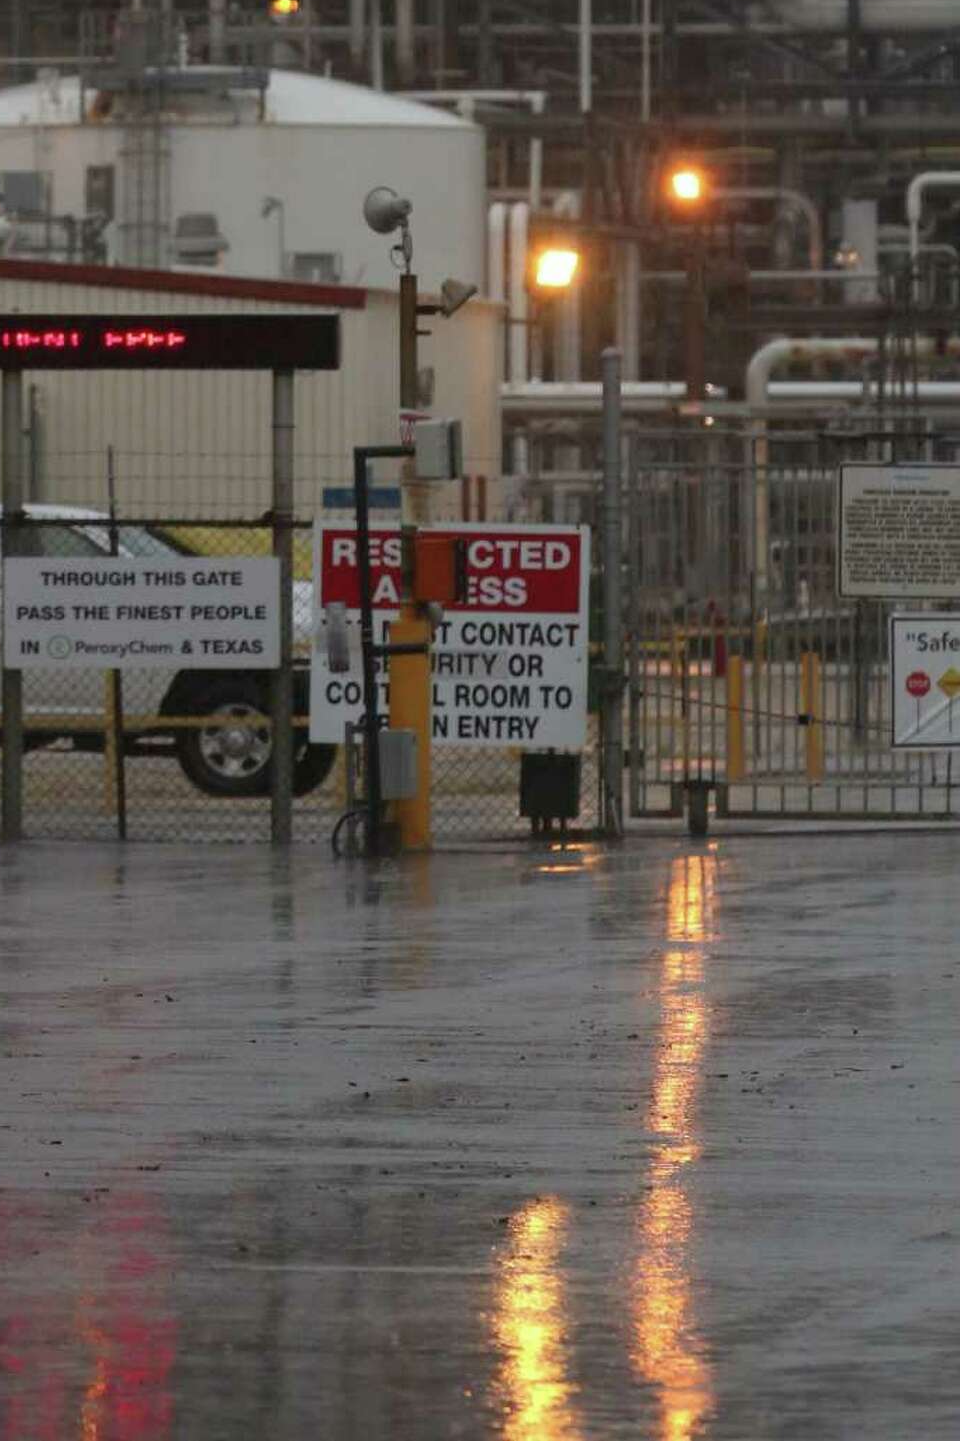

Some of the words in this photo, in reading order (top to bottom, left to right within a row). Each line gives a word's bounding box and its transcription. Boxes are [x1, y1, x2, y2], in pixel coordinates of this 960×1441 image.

[332, 538, 571, 570] RESCTED
[40, 571, 136, 587] THROUGH
[143, 571, 186, 587] THIS
[192, 571, 244, 587] GATE
[371, 574, 528, 607] ASS
[16, 605, 65, 621] PASS
[72, 605, 110, 621] THE
[116, 605, 184, 621] FINEST
[191, 605, 266, 621] PEOPLE
[461, 622, 579, 647] CONTACT
[20, 640, 39, 655] IN
[75, 640, 173, 658] PeroxyChem
[181, 639, 193, 655] &
[200, 639, 264, 655] TEXAS
[508, 653, 543, 677] OR
[326, 681, 445, 707] COTL
[455, 684, 531, 708] ROOM
[539, 685, 572, 709] TO
[457, 715, 539, 739] ENTRY
